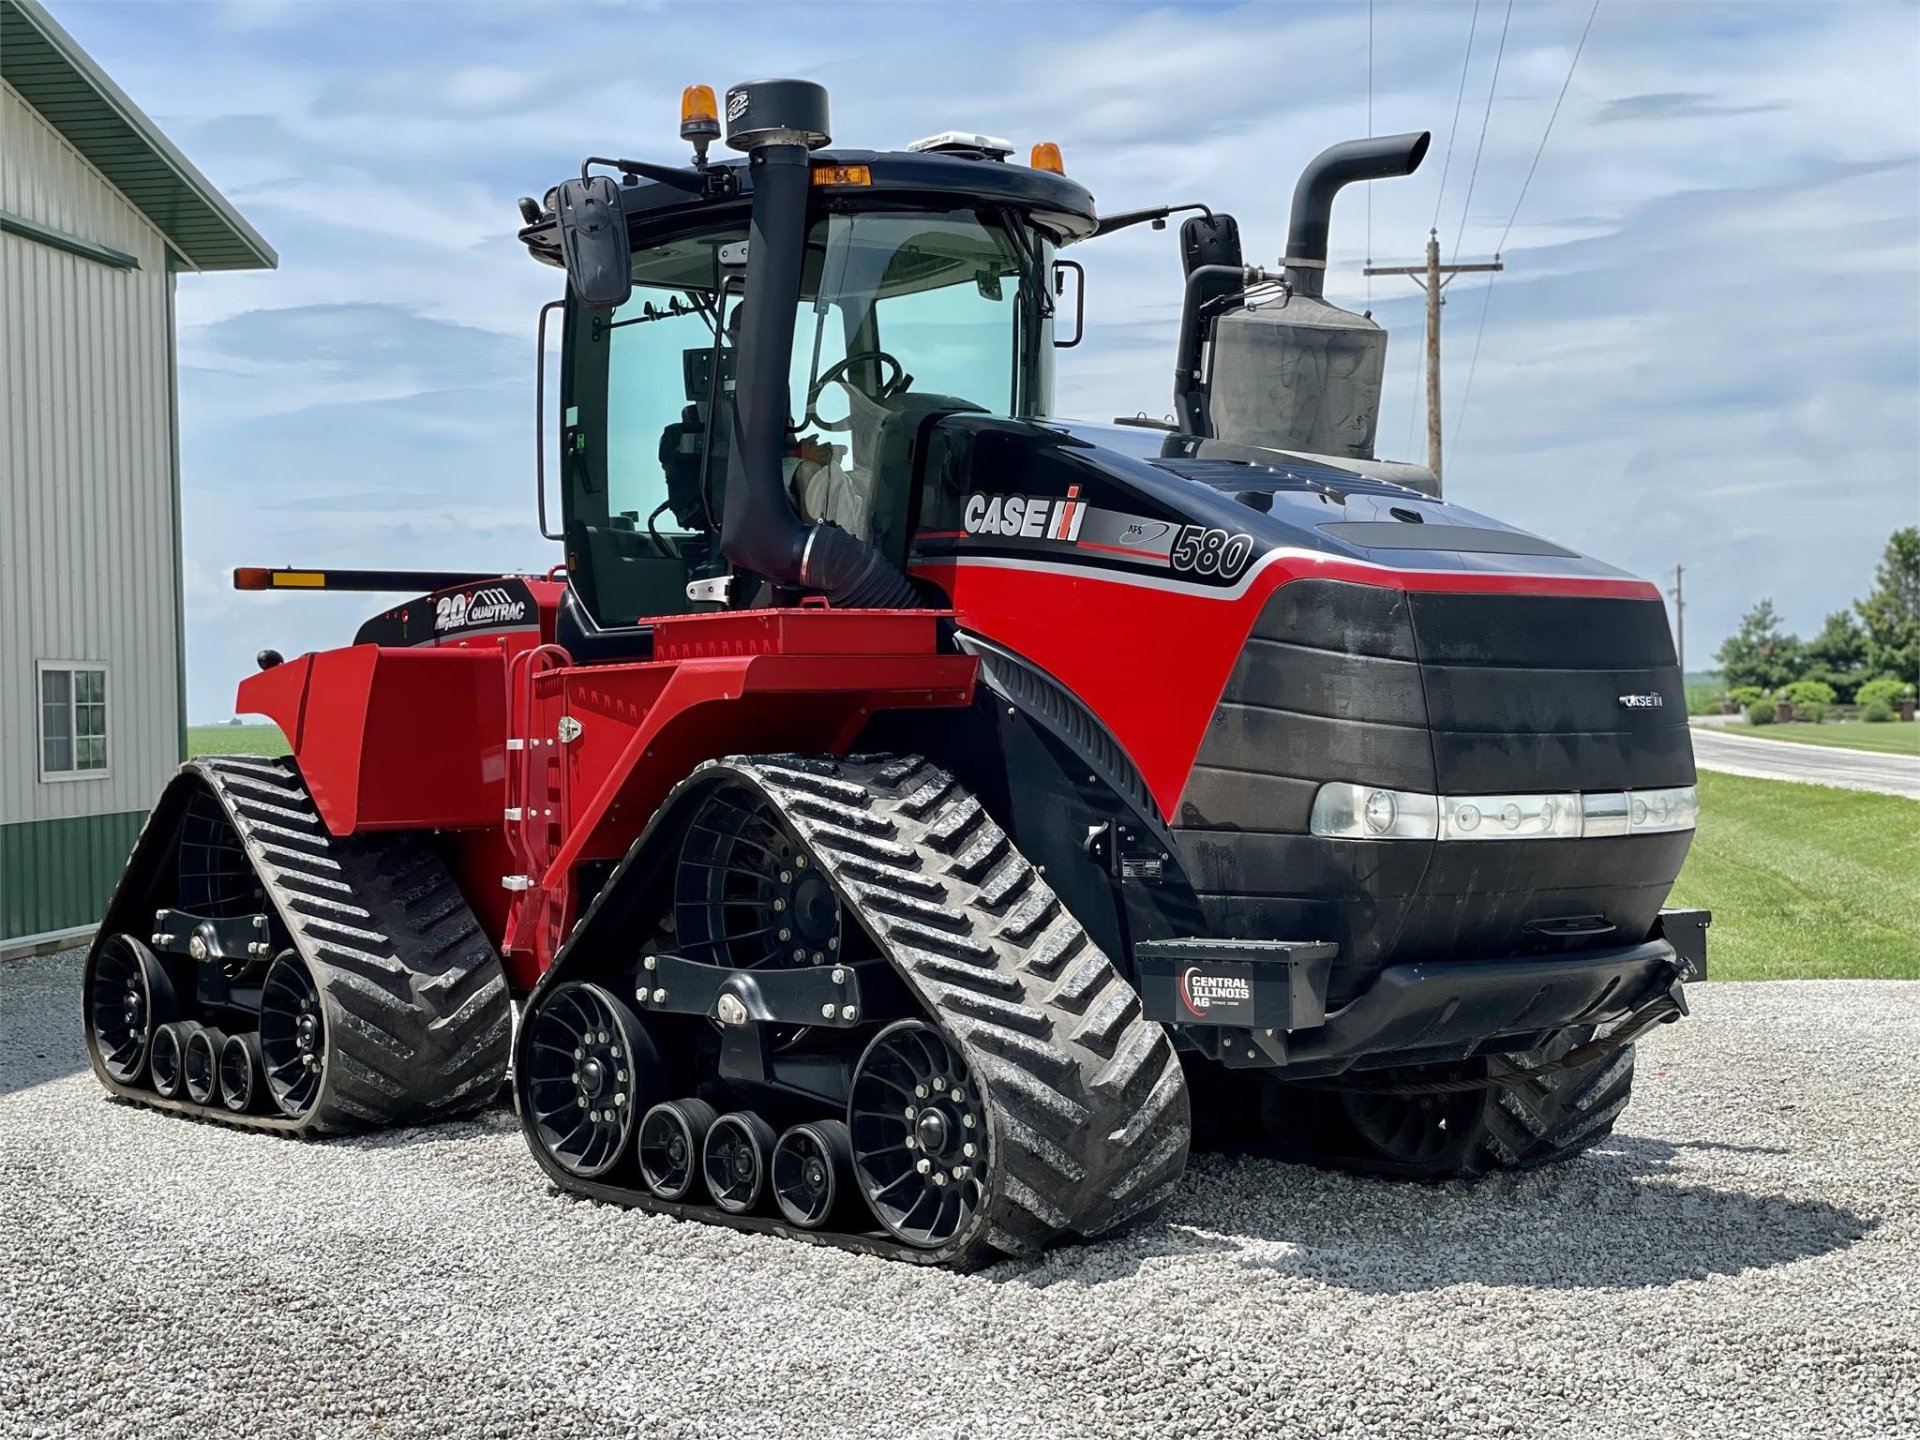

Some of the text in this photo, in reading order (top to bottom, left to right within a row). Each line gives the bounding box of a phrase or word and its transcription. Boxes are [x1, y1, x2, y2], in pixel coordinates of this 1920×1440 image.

[964, 494, 1050, 538] CASE
[1128, 524, 1142, 535] AFS
[1172, 524, 1254, 579] 580
[435, 593, 466, 631] 20
[471, 601, 525, 622] QUADTRAC
[444, 617, 465, 631] years
[1192, 976, 1248, 989] CENTRAL
[1192, 986, 1250, 999] ILLINOIS
[1193, 997, 1210, 1007] AG
